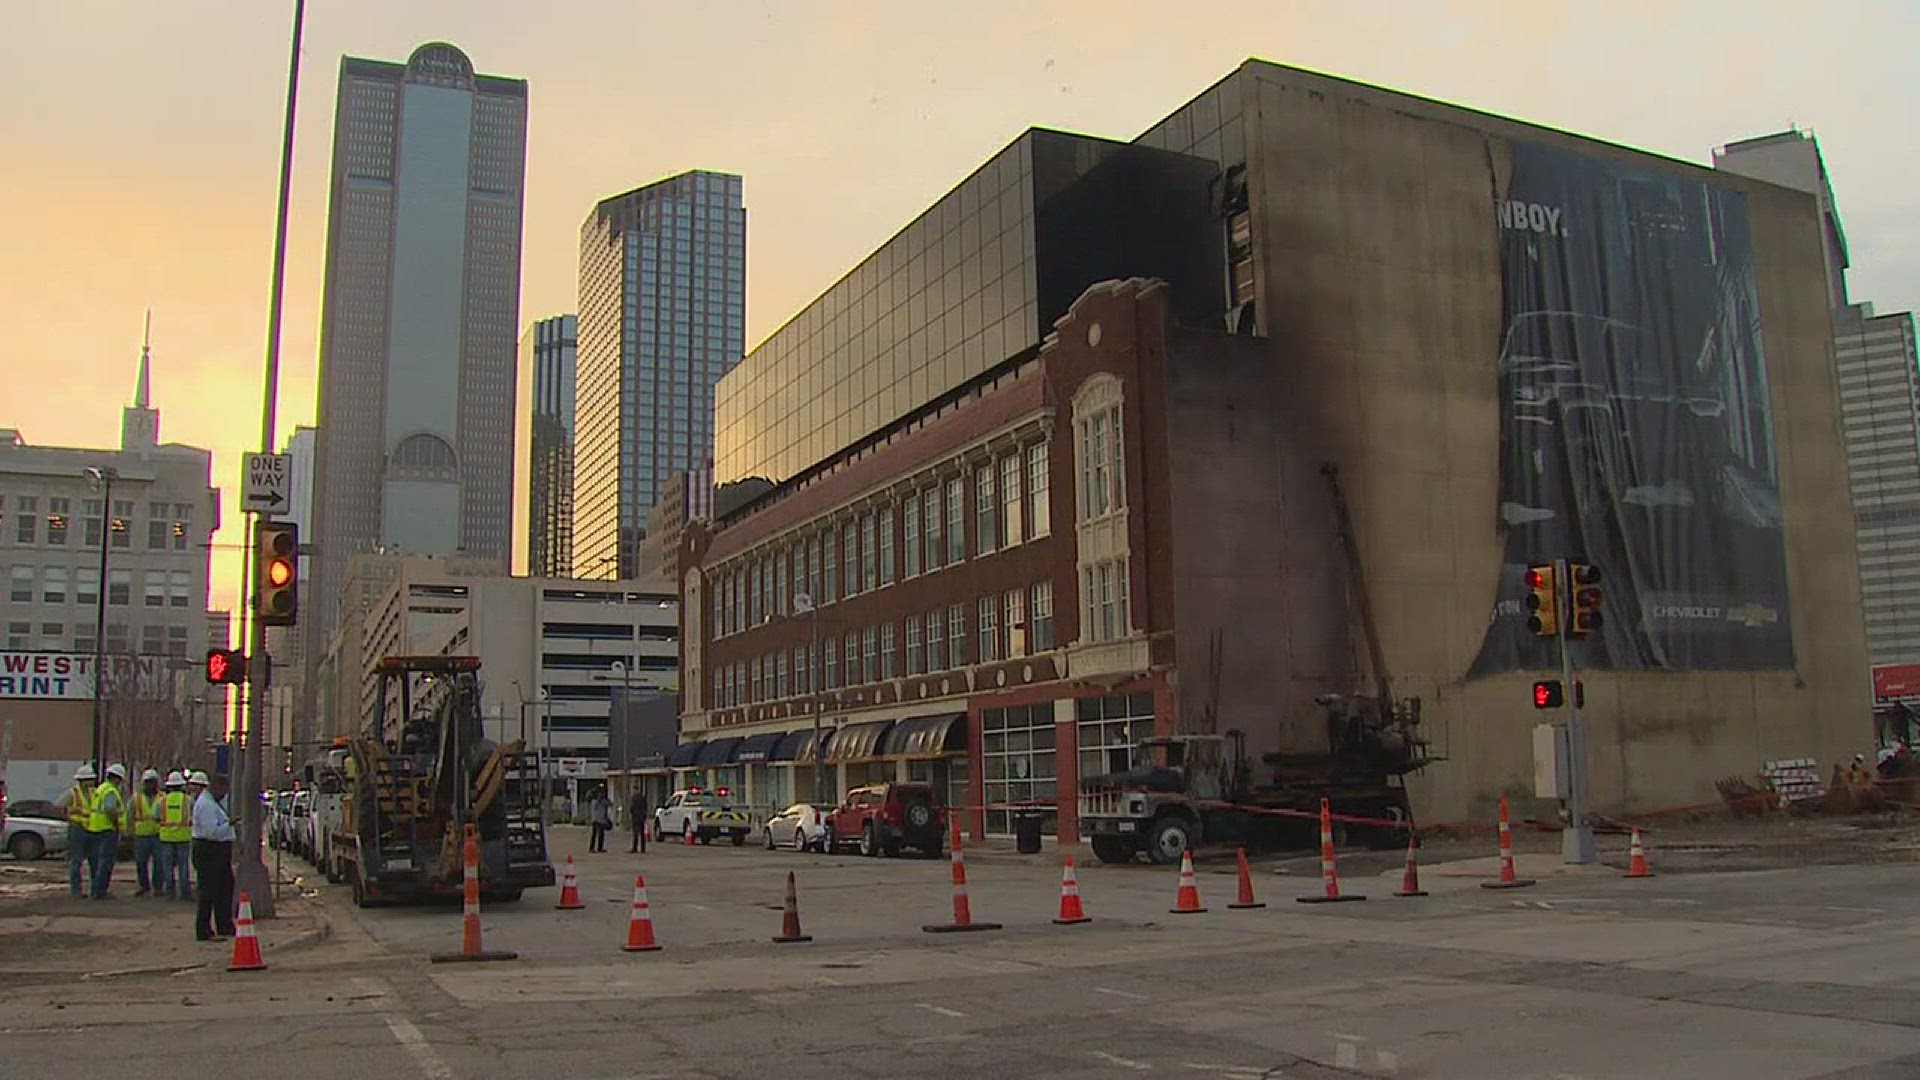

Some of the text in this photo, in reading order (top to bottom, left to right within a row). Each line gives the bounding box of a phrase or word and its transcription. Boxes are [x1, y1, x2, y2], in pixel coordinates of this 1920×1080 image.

[250, 456, 283, 471] ONE
[251, 472, 285, 487] WAY
[1653, 606, 1720, 619] CHEVROLET
